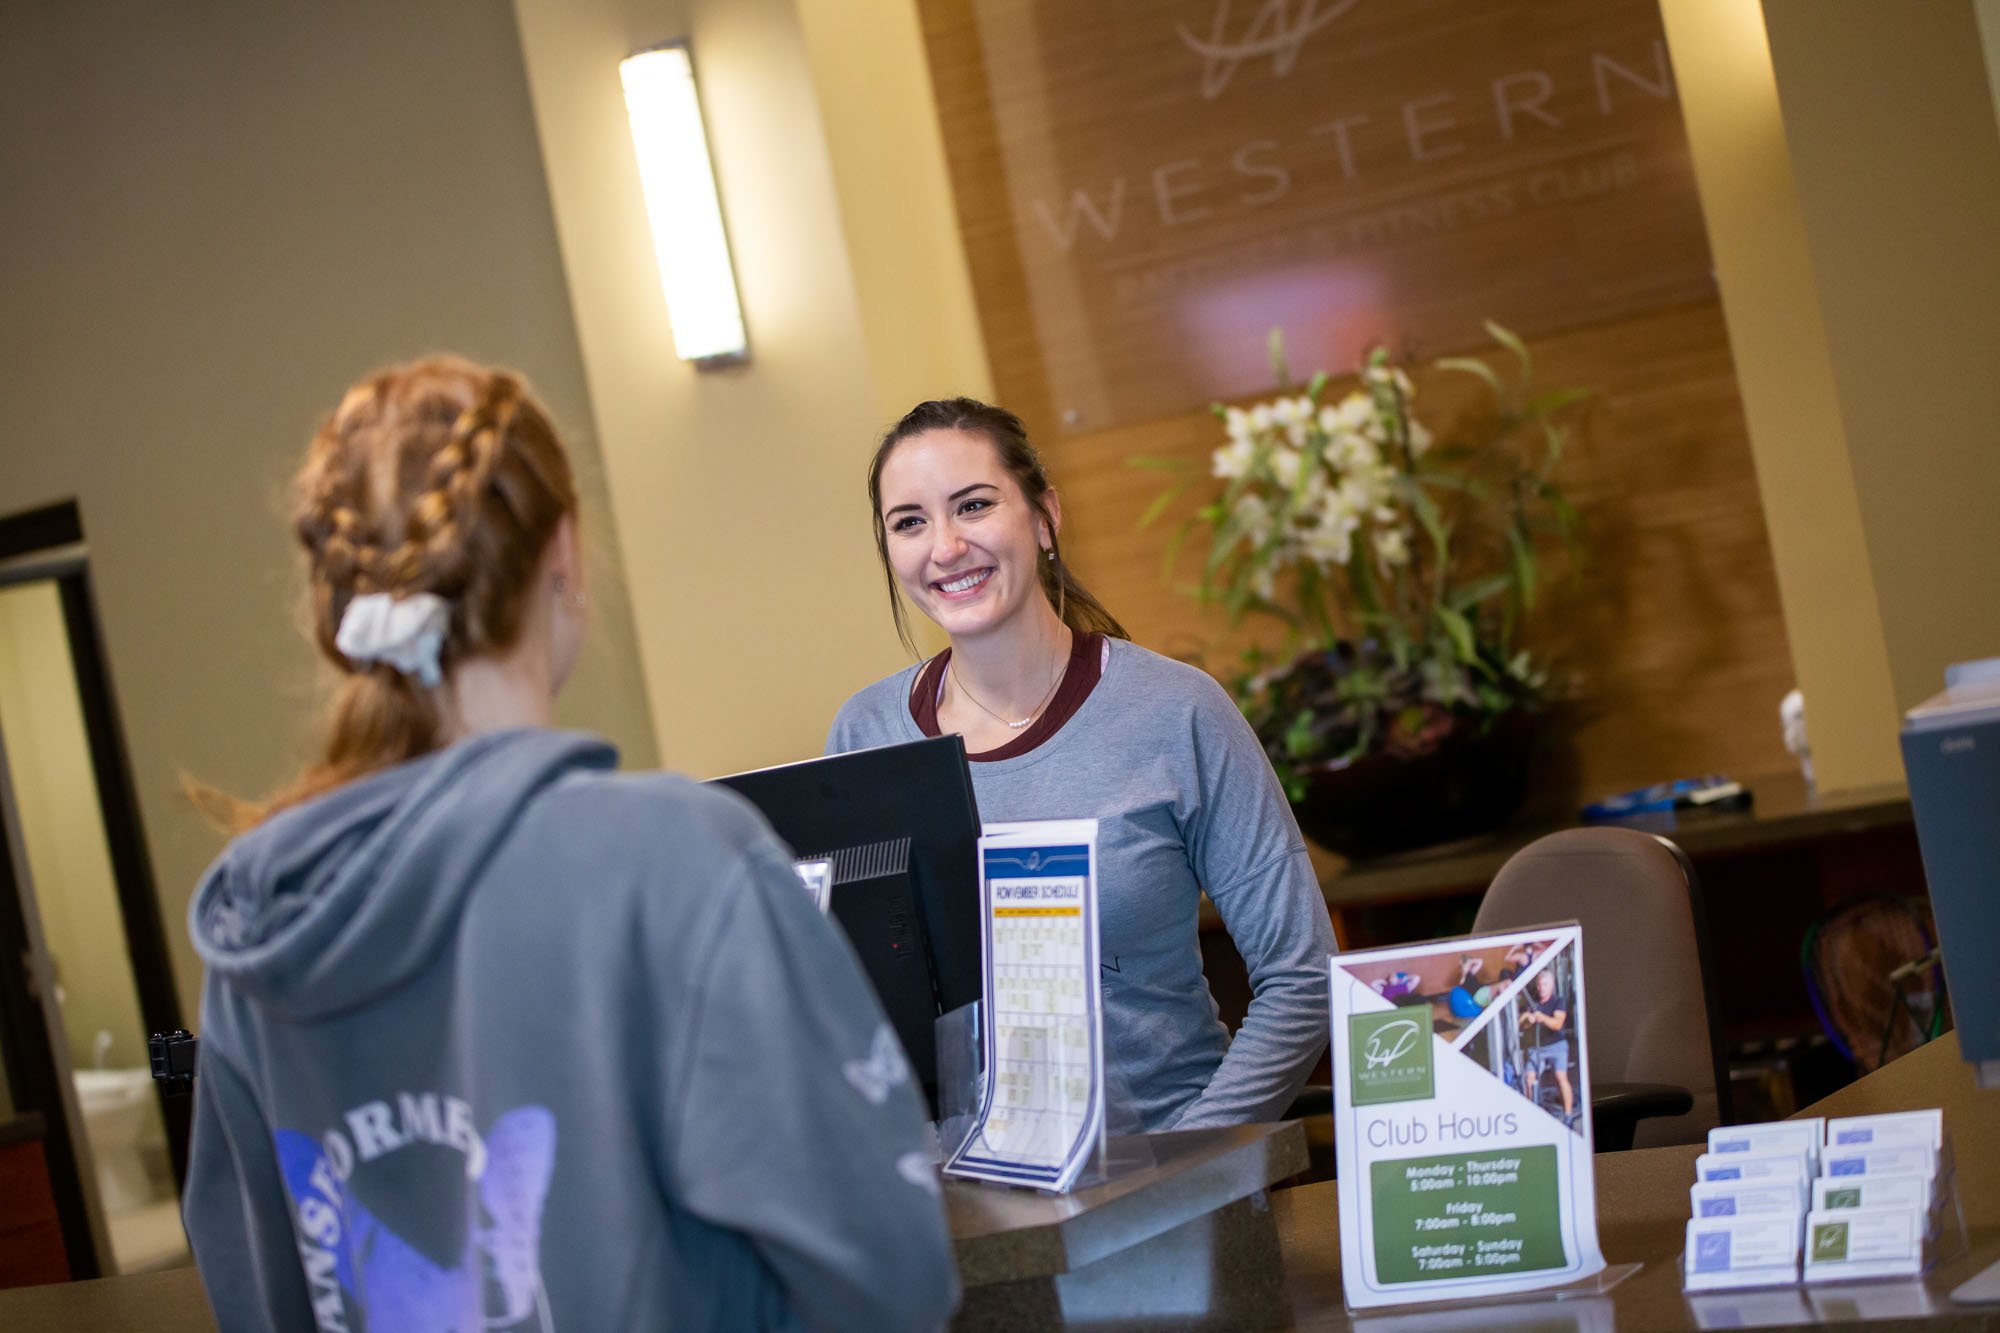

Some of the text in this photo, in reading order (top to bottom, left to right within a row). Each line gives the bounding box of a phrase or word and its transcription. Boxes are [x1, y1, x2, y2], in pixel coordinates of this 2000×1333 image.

[1033, 39, 1673, 251] WESTERN
[1347, 184, 1515, 250] FITNESS
[1529, 153, 1640, 204] CLUB
[1367, 1112, 1519, 1148] Club Hours
[1405, 1164, 1456, 1179] Monday
[1466, 1158, 1521, 1173] Thursday
[1466, 1172, 1518, 1187] 10:00pm
[1446, 1201, 1484, 1215] Friday
[1415, 1217, 1460, 1231] 7:00am
[1411, 1243, 1466, 1259] Saturday
[1477, 1238, 1524, 1253] Sunday
[1418, 1257, 1464, 1271] 7:00am
